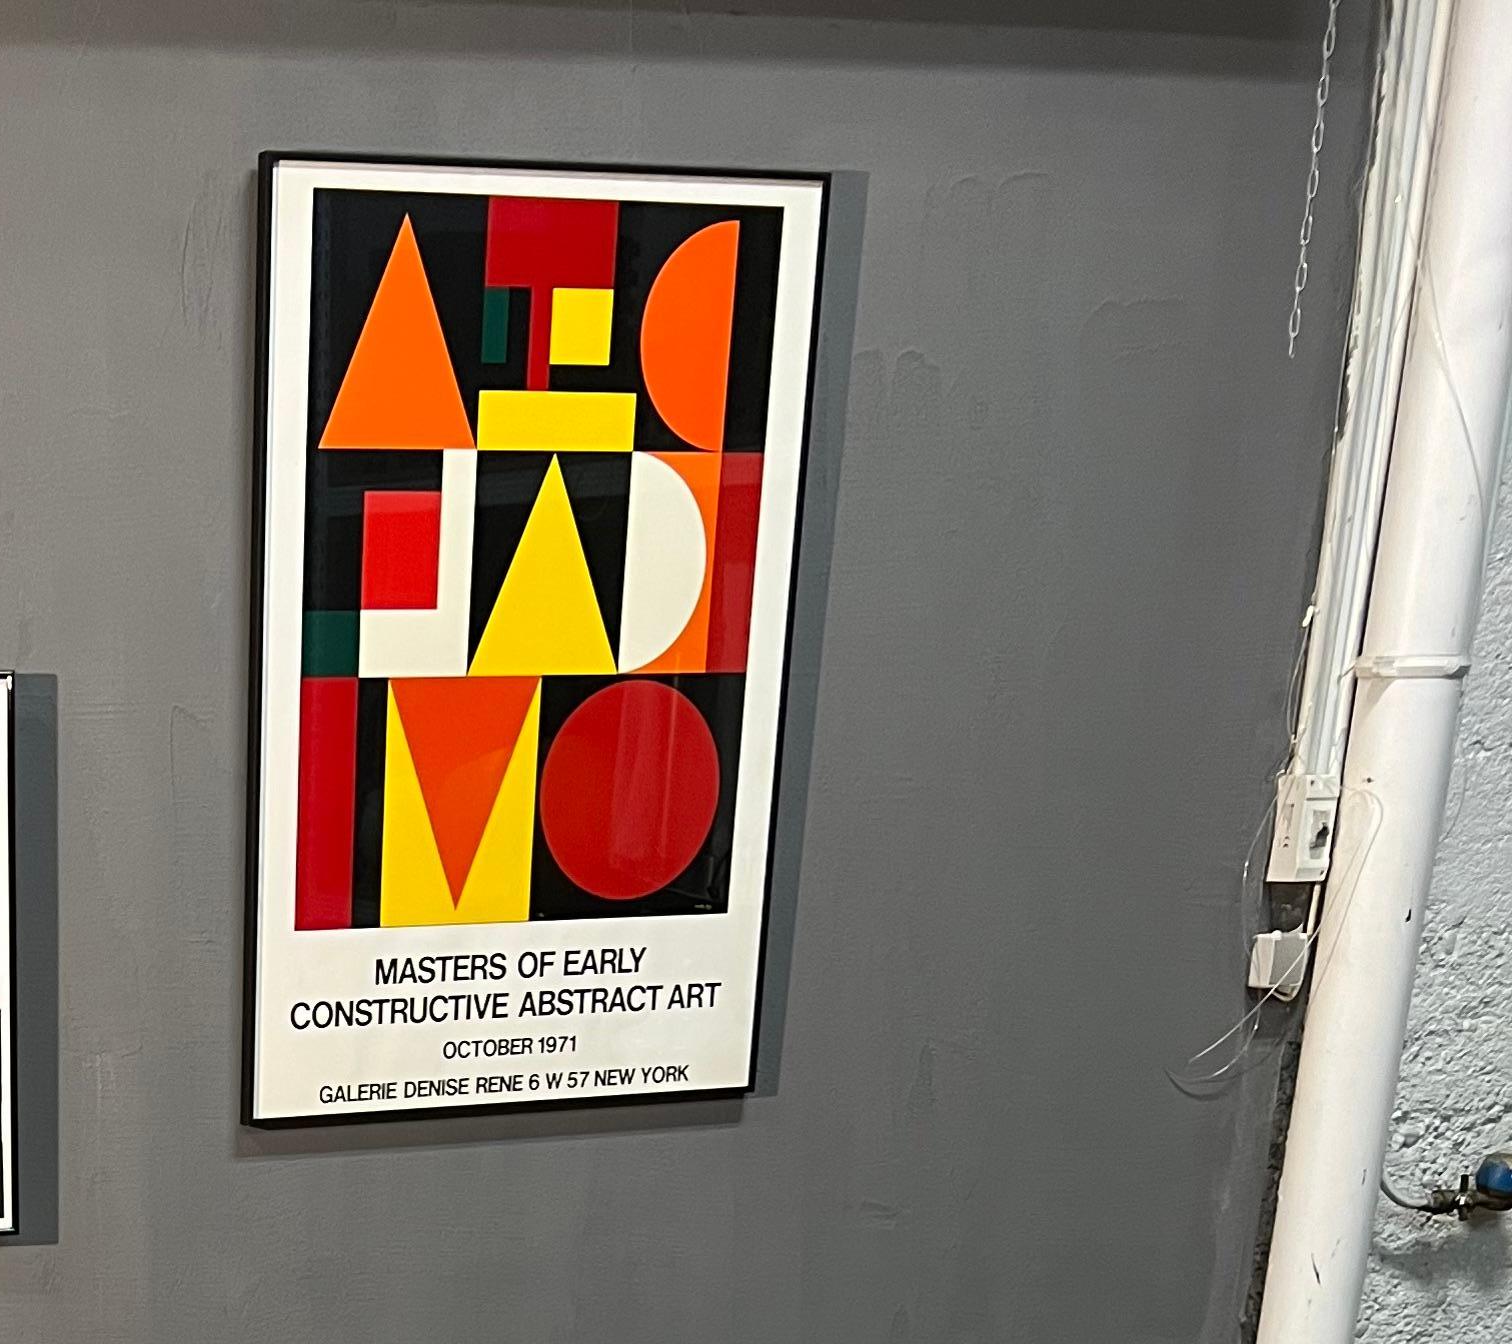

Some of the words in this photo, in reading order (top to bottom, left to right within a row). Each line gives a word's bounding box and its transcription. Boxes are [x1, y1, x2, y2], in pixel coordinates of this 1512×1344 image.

[374, 952, 507, 986] MASTERS
[517, 951, 556, 979] OF
[563, 946, 647, 976] EARLY
[290, 992, 510, 1030] CONSTRUCTIVE
[518, 984, 664, 1018] ABSTRACT
[667, 982, 723, 1010] ART
[442, 1037, 534, 1060] OCTOBER
[538, 1035, 577, 1054] 1971
[319, 1082, 398, 1104] GALERIE
[404, 1077, 470, 1099] DENISE
[475, 1074, 524, 1094] RENE
[528, 1073, 540, 1091] 6
[545, 1071, 564, 1090] W
[566, 1071, 590, 1088] 57
[593, 1067, 637, 1087] NEW
[641, 1064, 690, 1084] YORK
